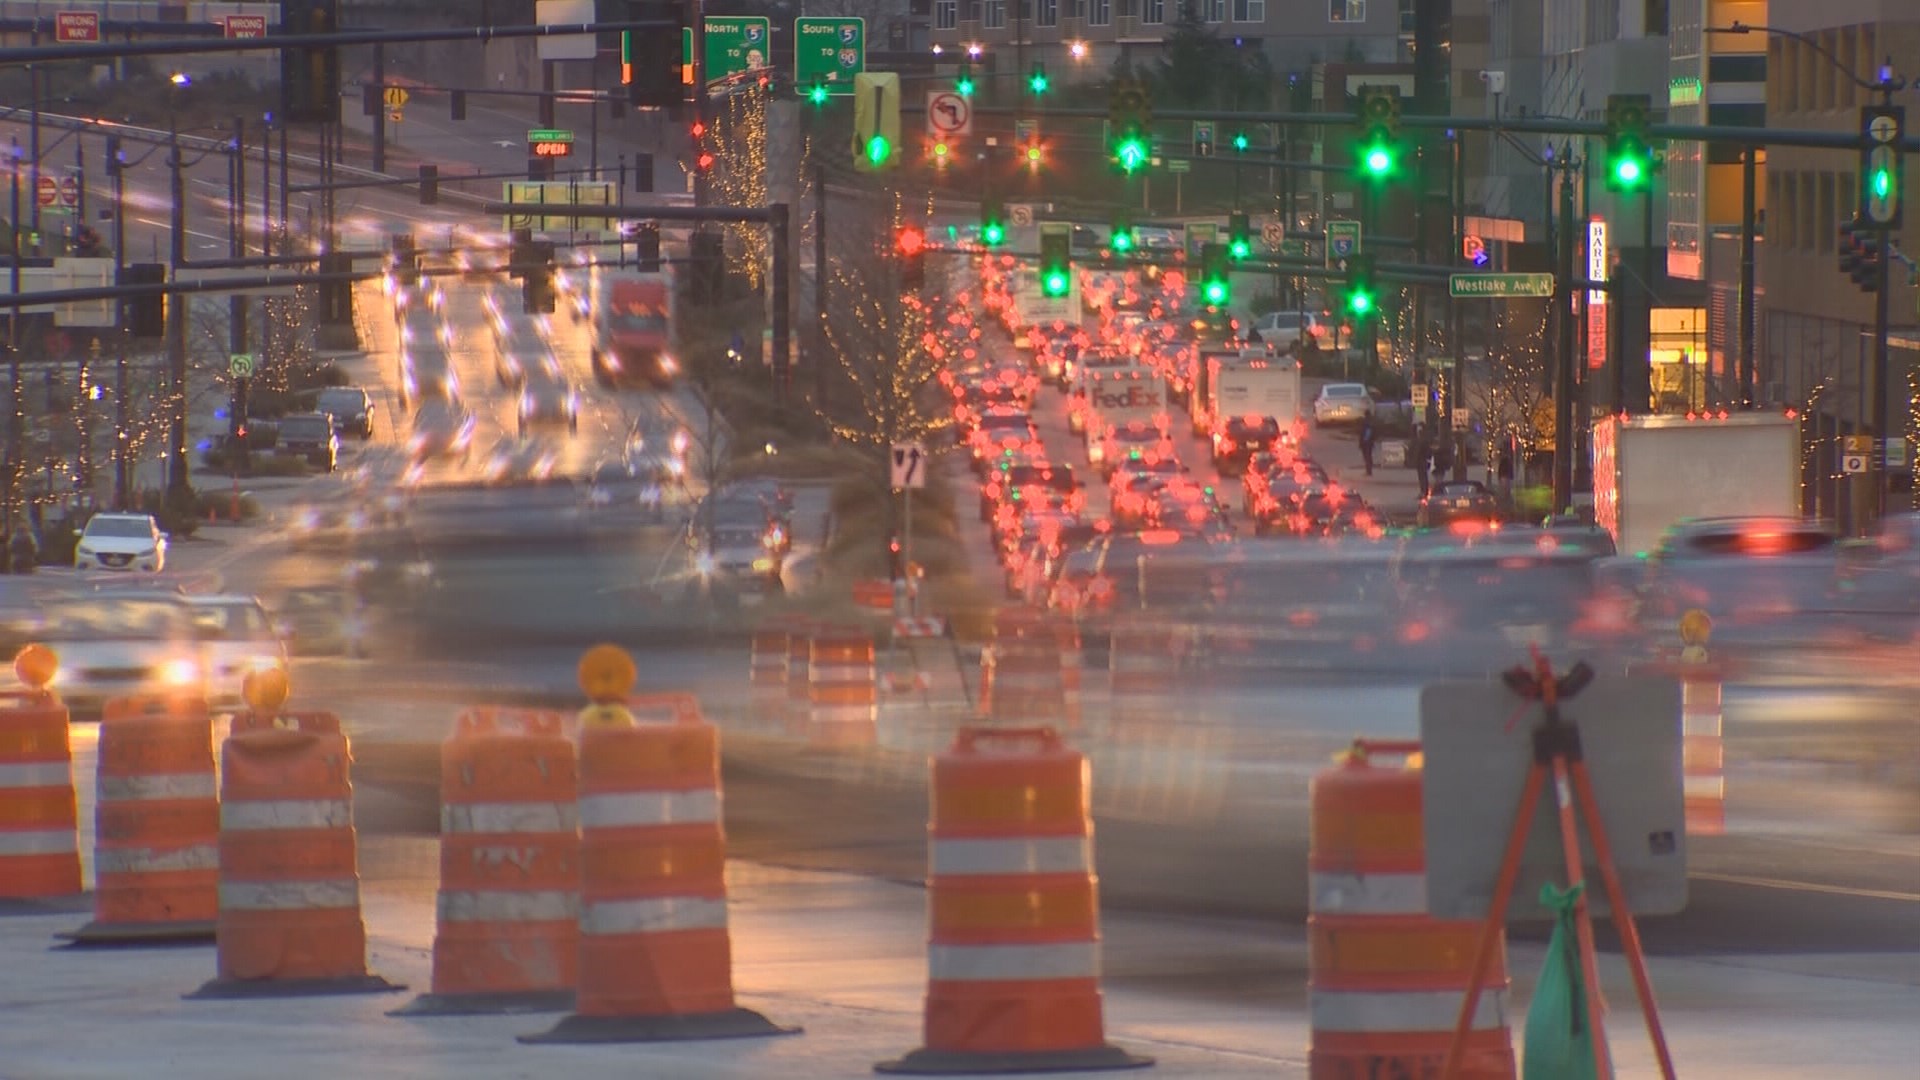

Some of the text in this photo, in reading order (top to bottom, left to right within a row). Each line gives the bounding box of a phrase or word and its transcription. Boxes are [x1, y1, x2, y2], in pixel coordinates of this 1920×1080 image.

[61, 15, 95, 26] WRONG
[229, 19, 263, 29] WRONG
[67, 28, 89, 38] WAY
[704, 23, 759, 40] NORTH 5
[802, 24, 852, 42] SOUTH 5
[726, 48, 740, 57] TO
[821, 48, 856, 64] TO 90
[535, 143, 567, 155] OPEN
[1592, 226, 1603, 299] BARTEL
[1454, 279, 1550, 292] Westlake Ave N
[1092, 385, 1162, 409] FedEx
[1847, 436, 1860, 451] 2
